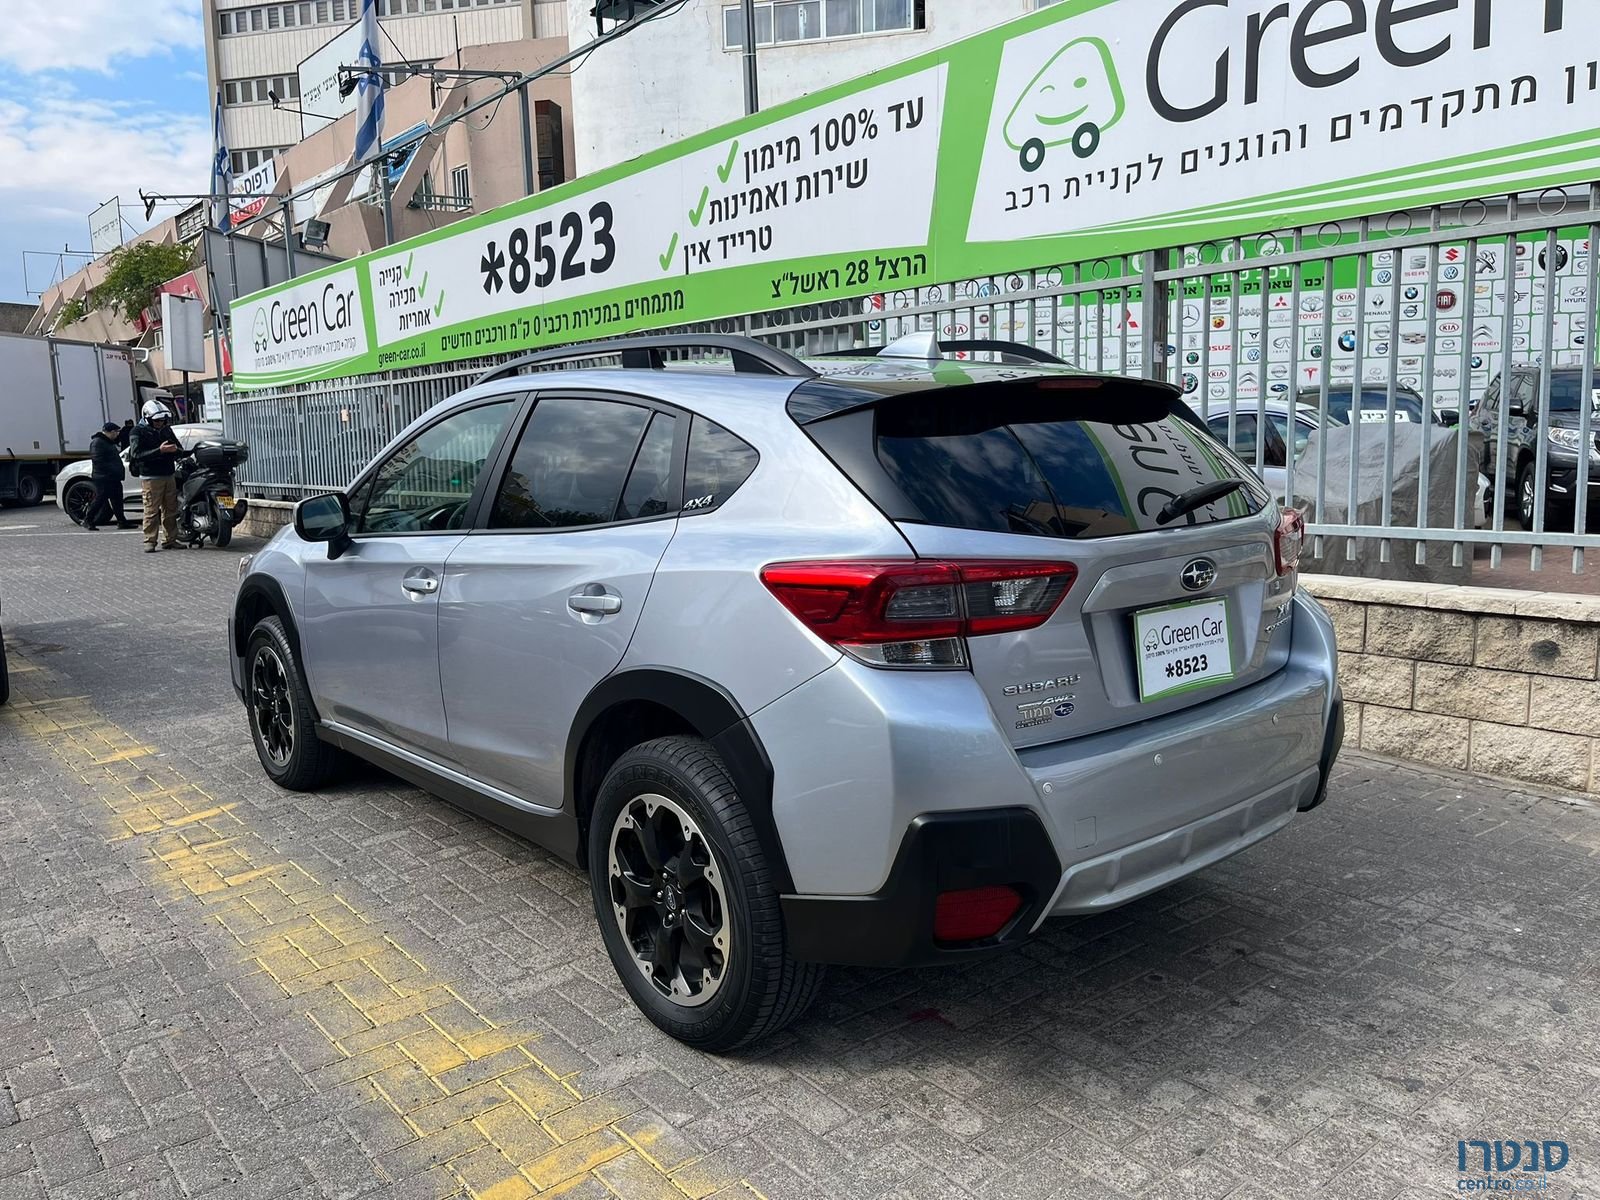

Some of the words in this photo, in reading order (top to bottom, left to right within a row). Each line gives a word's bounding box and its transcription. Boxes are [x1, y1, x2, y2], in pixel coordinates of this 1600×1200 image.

[888, 96, 924, 133] עד
[1330, 75, 1537, 142] מתקדמים
[810, 108, 878, 156] 100%
[743, 136, 801, 184] מימון
[1180, 122, 1307, 176] והוגנים
[796, 158, 868, 203] שירות
[1063, 152, 1164, 201] לקניית
[708, 180, 788, 225] ואמינות
[1005, 182, 1051, 211] רכב
[717, 224, 772, 259] טרייד
[683, 239, 711, 275] אין
[875, 253, 926, 281] הרצל
[379, 265, 402, 287] קנייה
[845, 259, 869, 286] 28
[389, 286, 416, 308] מכירה
[625, 289, 684, 319] מתמחים
[1438, 295, 1452, 306] FIAT
[270, 300, 319, 344] Green
[322, 283, 354, 332] Car
[399, 307, 431, 331] אחריות
[533, 316, 541, 337] 0
[543, 311, 569, 334] רכבי
[573, 304, 620, 330] במכירת
[441, 330, 472, 351] חדשים
[475, 324, 507, 346] ורכבים
[378, 342, 426, 368] green-car.co.il
[1161, 625, 1200, 646] Green
[1202, 617, 1223, 637] Car
[1003, 674, 1081, 696] SUBARU
